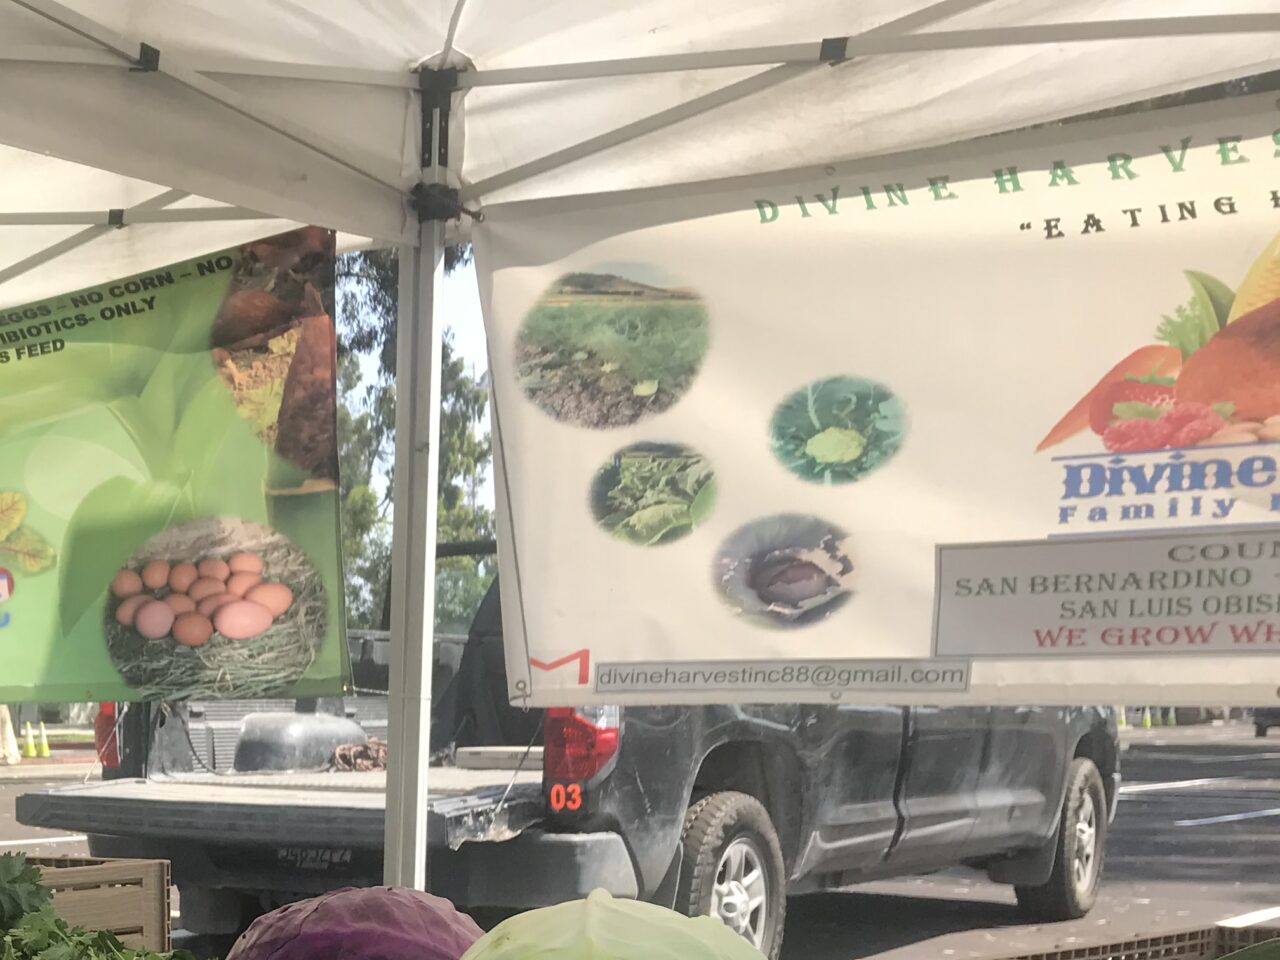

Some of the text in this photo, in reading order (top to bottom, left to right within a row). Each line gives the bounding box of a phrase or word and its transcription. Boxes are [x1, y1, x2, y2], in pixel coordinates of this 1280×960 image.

[753, 175, 959, 224] DIVINE
[70, 291, 104, 309] NO
[109, 271, 175, 298] CORN
[196, 255, 233, 276] NO
[100, 296, 156, 320] ONLY
[15, 338, 65, 360] FEED
[1061, 451, 1277, 499] Divine
[1058, 496, 1237, 524] Family
[954, 567, 1253, 598] SAN BERNARDINO
[1060, 594, 1280, 620] SAN LUIS OBIS
[1033, 627, 1087, 648] WE
[1100, 621, 1219, 647] GROW
[599, 665, 964, 686] divineharvestinc88@gmail.com
[549, 784, 583, 811] 03
